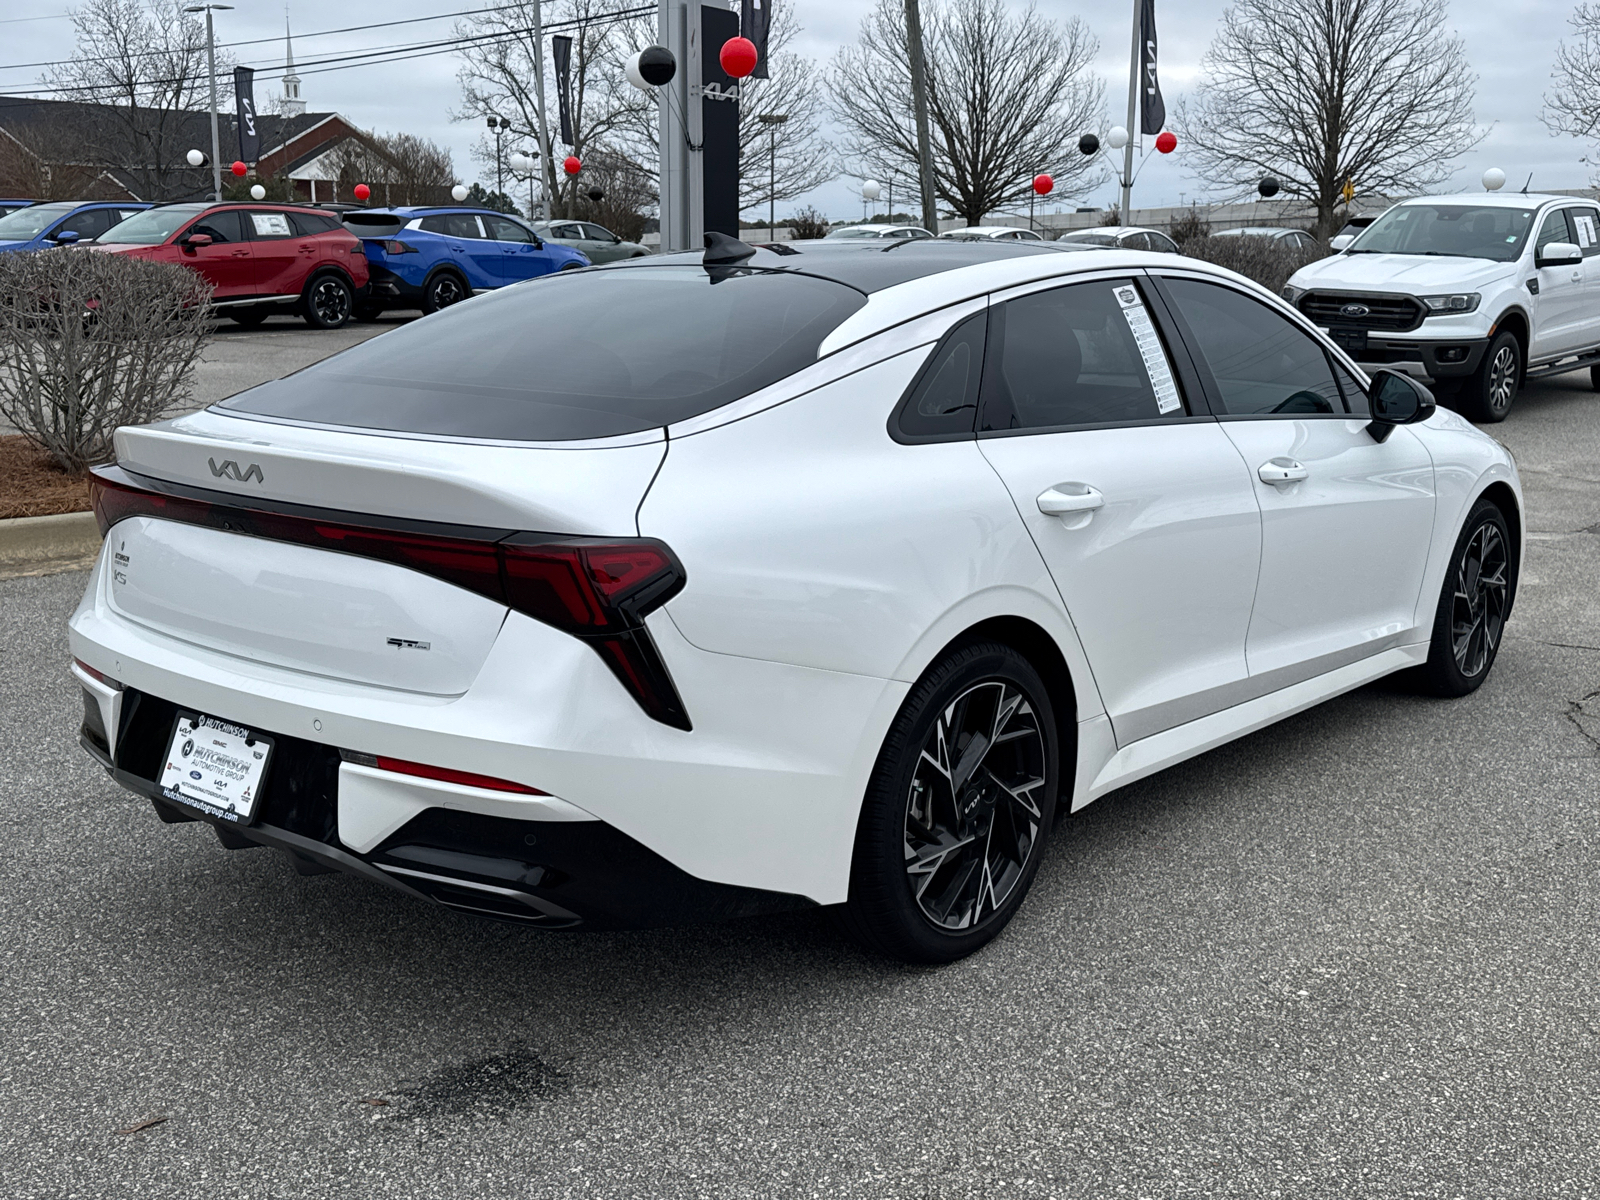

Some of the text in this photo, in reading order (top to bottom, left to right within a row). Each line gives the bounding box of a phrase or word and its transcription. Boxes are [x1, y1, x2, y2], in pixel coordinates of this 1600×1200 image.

[208, 457, 264, 484] KIA
[206, 718, 249, 738] HUTCHINSON
[213, 739, 227, 749] GMC
[191, 759, 245, 782] AUTOMOTIVE GROUP
[193, 746, 251, 774] HUTCHINSON
[163, 788, 239, 822] Hutchinsonautogroup.com
